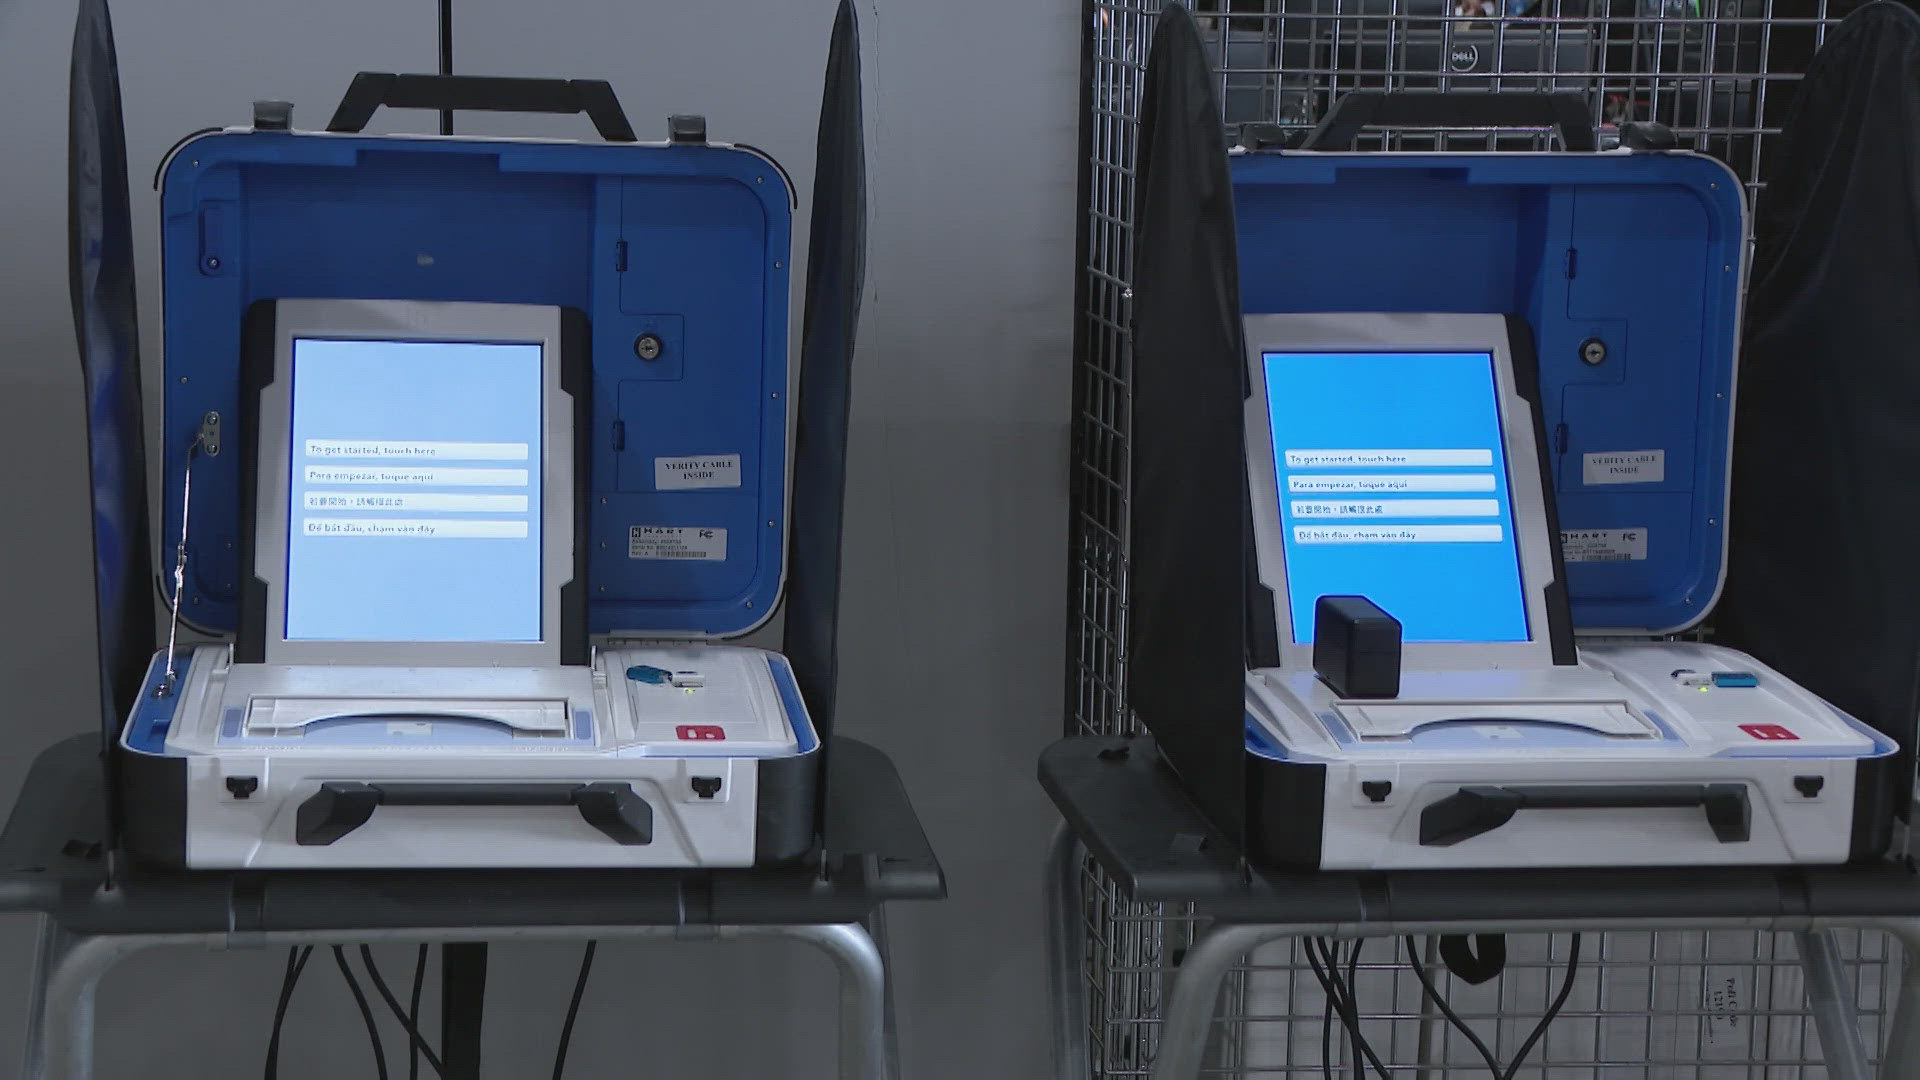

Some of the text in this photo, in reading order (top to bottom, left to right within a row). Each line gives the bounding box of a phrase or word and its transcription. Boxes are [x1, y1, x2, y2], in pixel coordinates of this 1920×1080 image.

[1452, 52, 1474, 61] DELL
[311, 445, 321, 453] To
[325, 446, 341, 455] get
[344, 446, 380, 455] started,
[414, 447, 436, 455] here
[1304, 456, 1318, 465] get
[1321, 455, 1356, 463] started,
[1627, 455, 1656, 463] CABLE
[702, 460, 733, 468] CABLE
[310, 471, 331, 479] Para
[334, 473, 378, 481] empezar,
[381, 473, 409, 482] toque
[683, 471, 714, 479] INSIDE
[1316, 482, 1356, 490] empezar,
[1358, 481, 1385, 490] toque
[1570, 532, 1607, 540] HART
